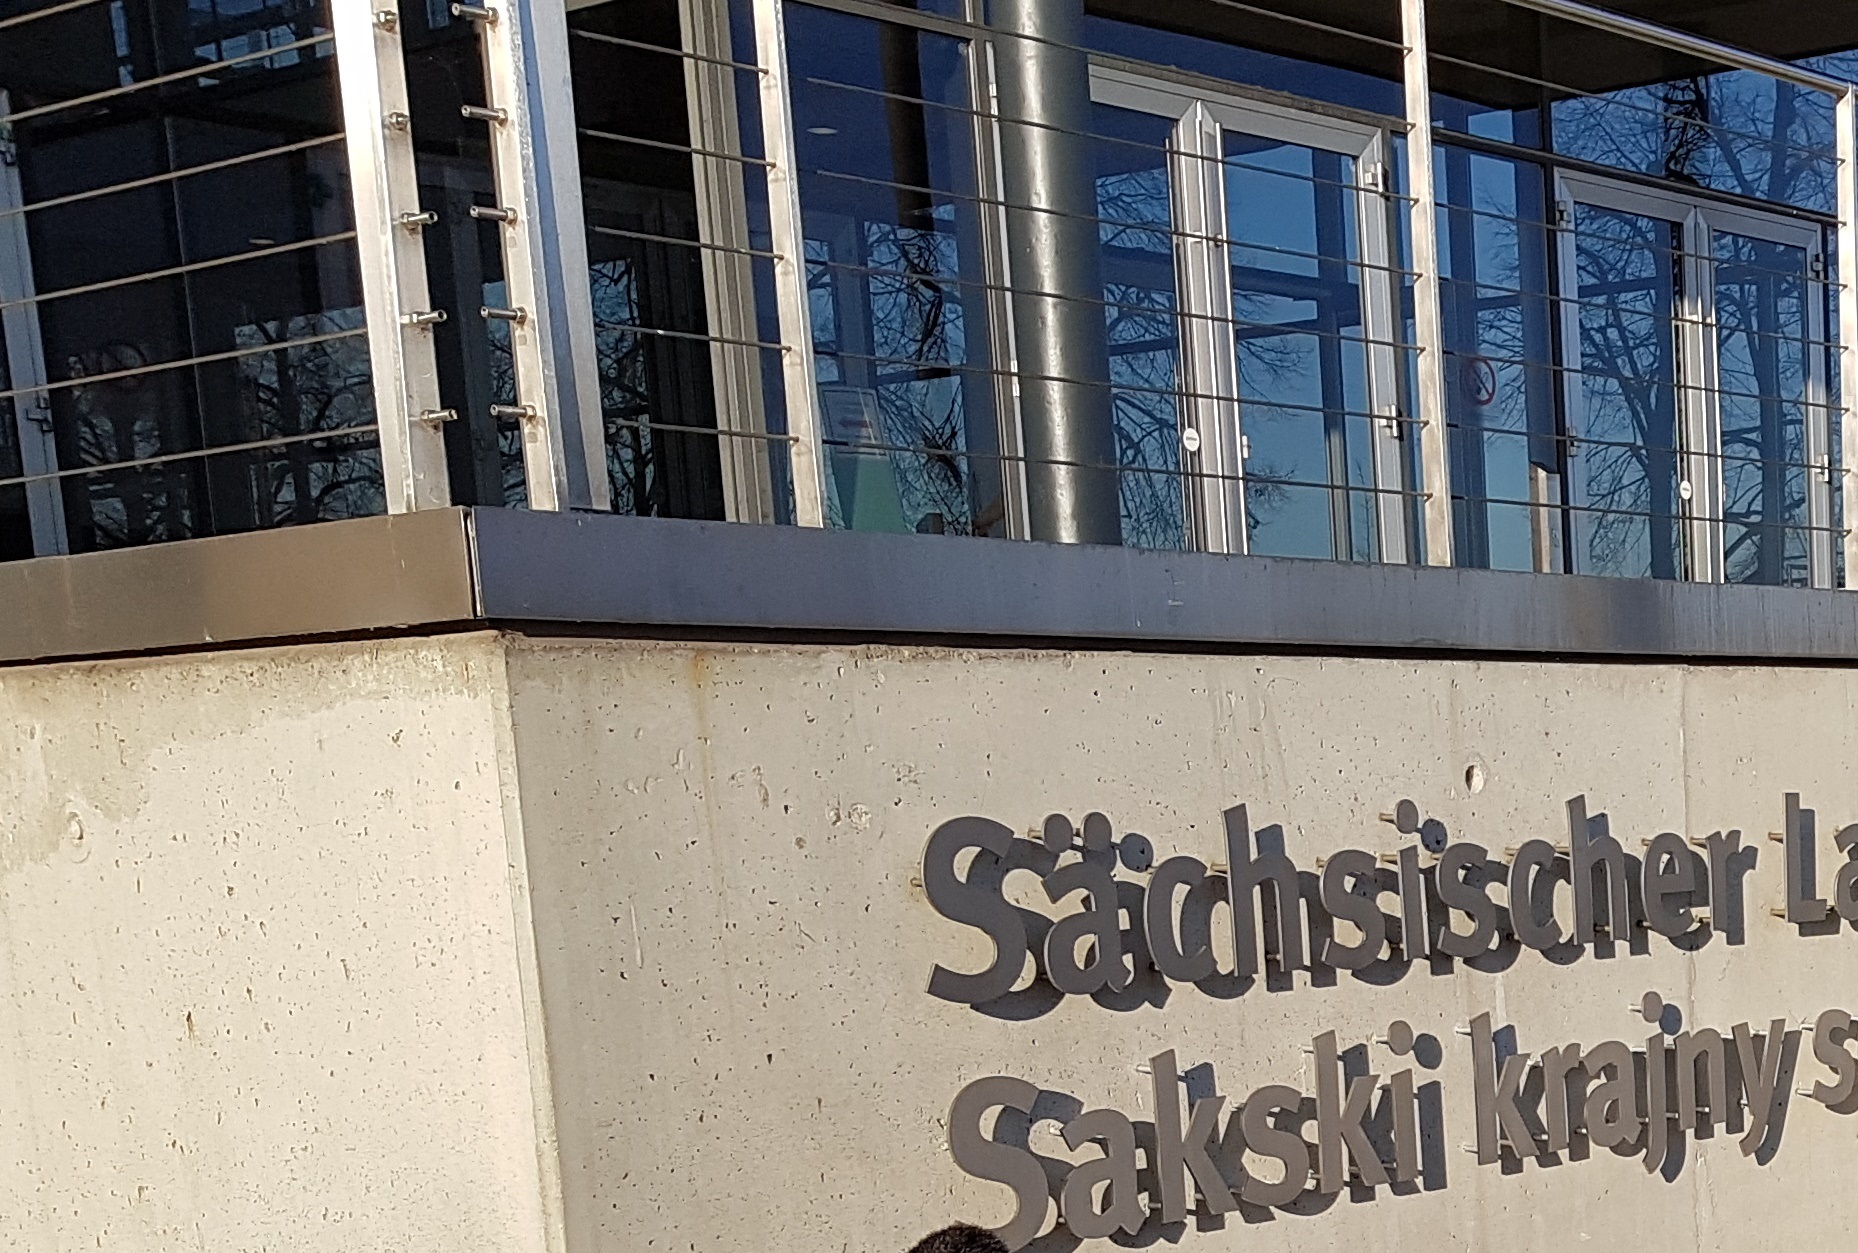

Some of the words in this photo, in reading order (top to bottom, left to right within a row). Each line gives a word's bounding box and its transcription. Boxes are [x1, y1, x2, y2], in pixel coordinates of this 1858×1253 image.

[922, 794, 1742, 1004] Sächsischer
[948, 1019, 1419, 1253] Sakski
[1469, 991, 1787, 1174] krajny
